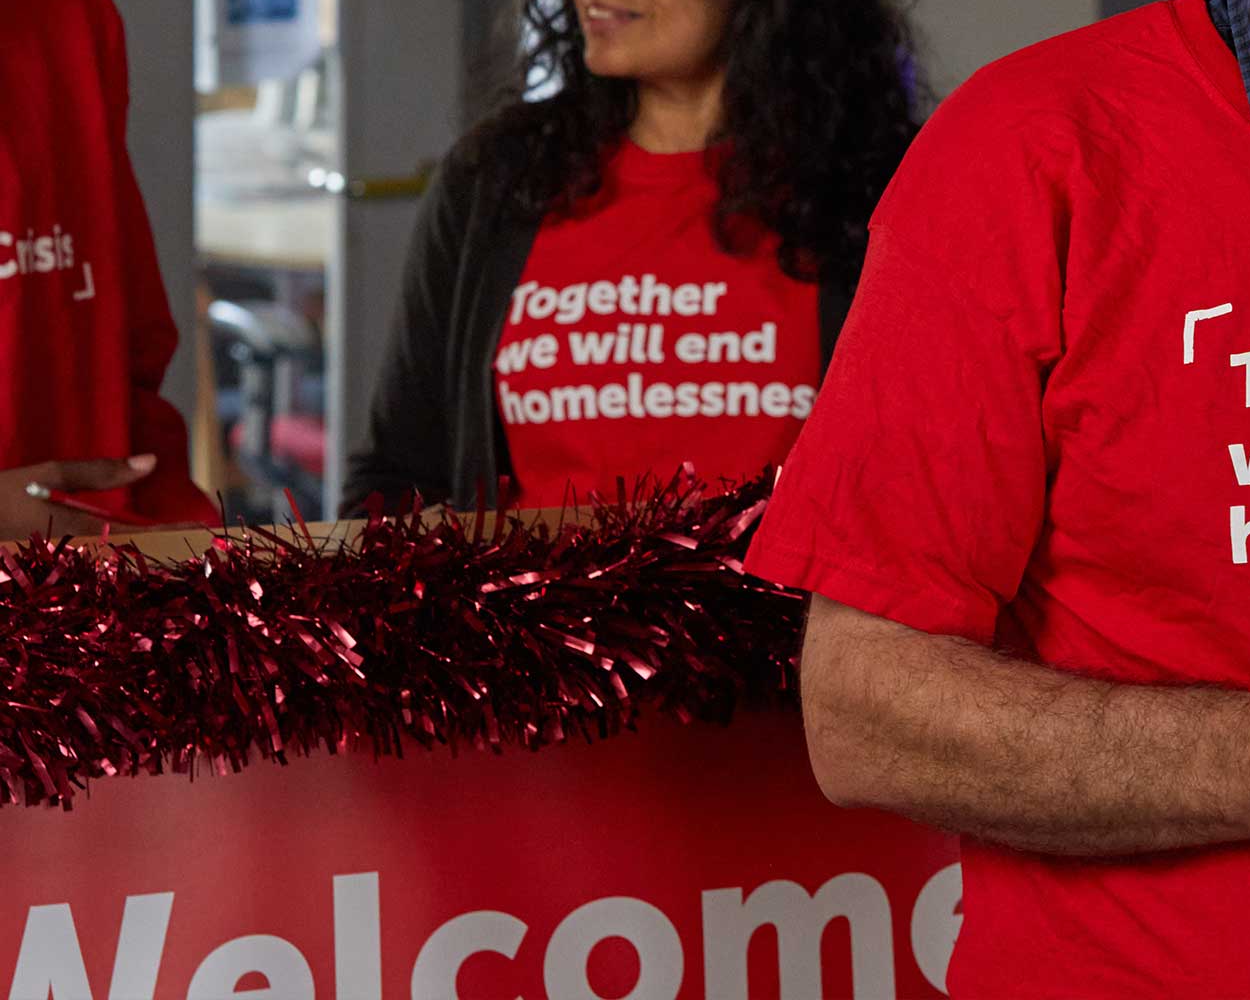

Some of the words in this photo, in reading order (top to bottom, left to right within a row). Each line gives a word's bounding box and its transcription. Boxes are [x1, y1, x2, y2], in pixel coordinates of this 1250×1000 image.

[511, 274, 727, 325] Together
[496, 334, 559, 374] we
[568, 323, 665, 365] will
[675, 322, 777, 364] end
[499, 372, 817, 425] homelessnes
